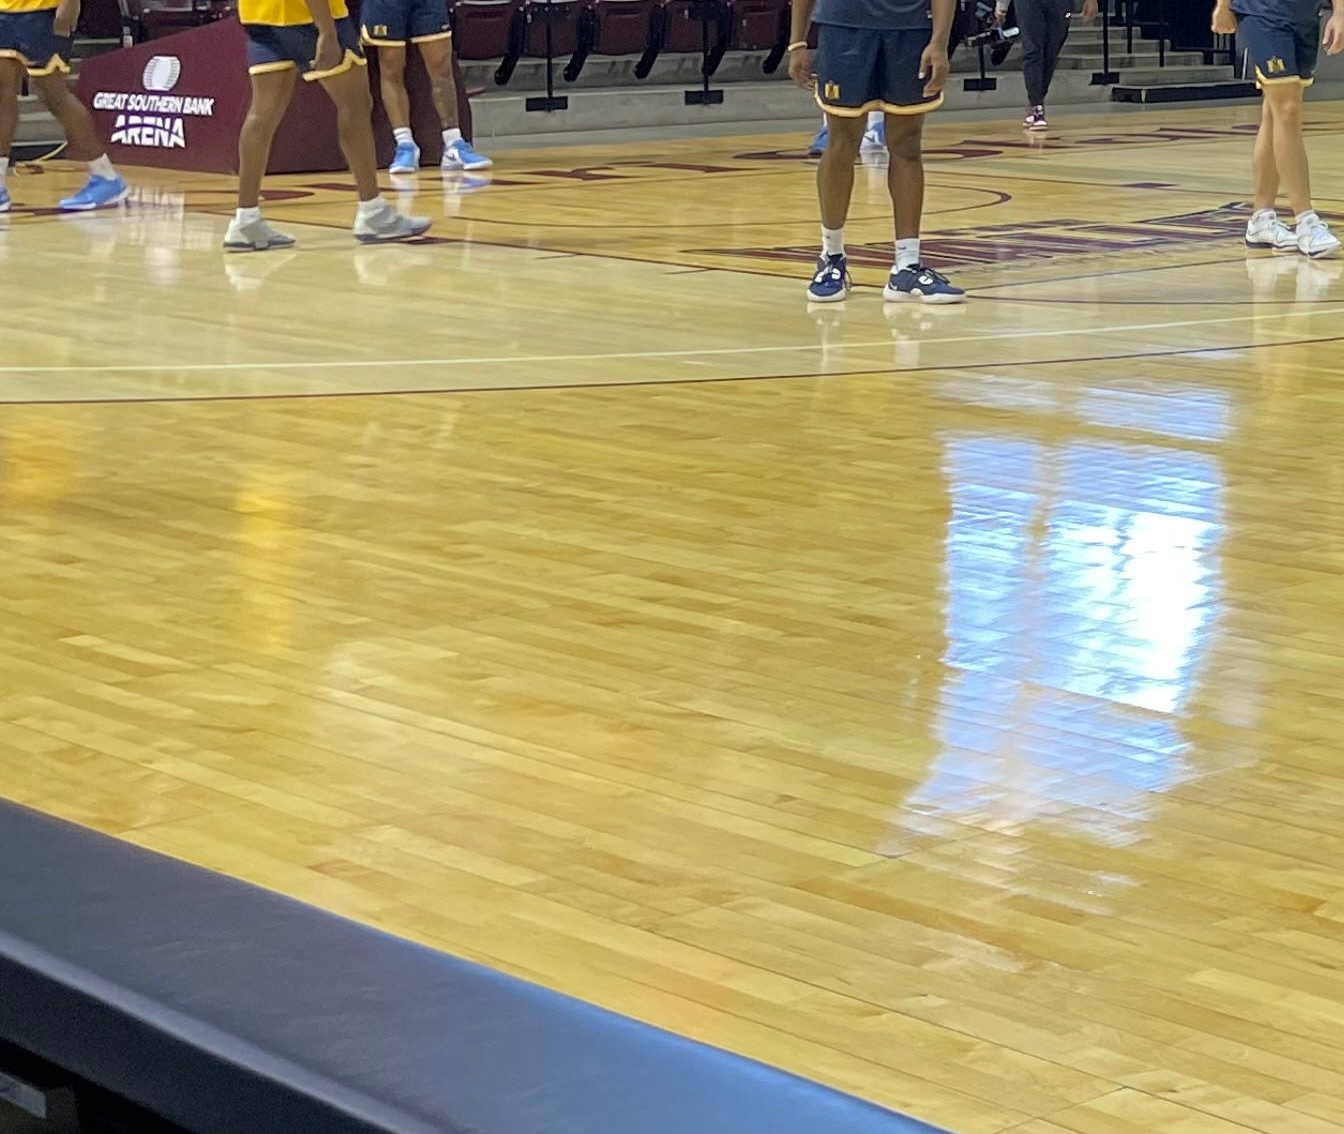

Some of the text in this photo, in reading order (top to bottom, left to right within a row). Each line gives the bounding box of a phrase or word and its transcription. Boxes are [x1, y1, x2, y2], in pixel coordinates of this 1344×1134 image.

[93, 92, 215, 115] GREAT SOUTHERN BANK
[110, 114, 186, 149] ARENA
